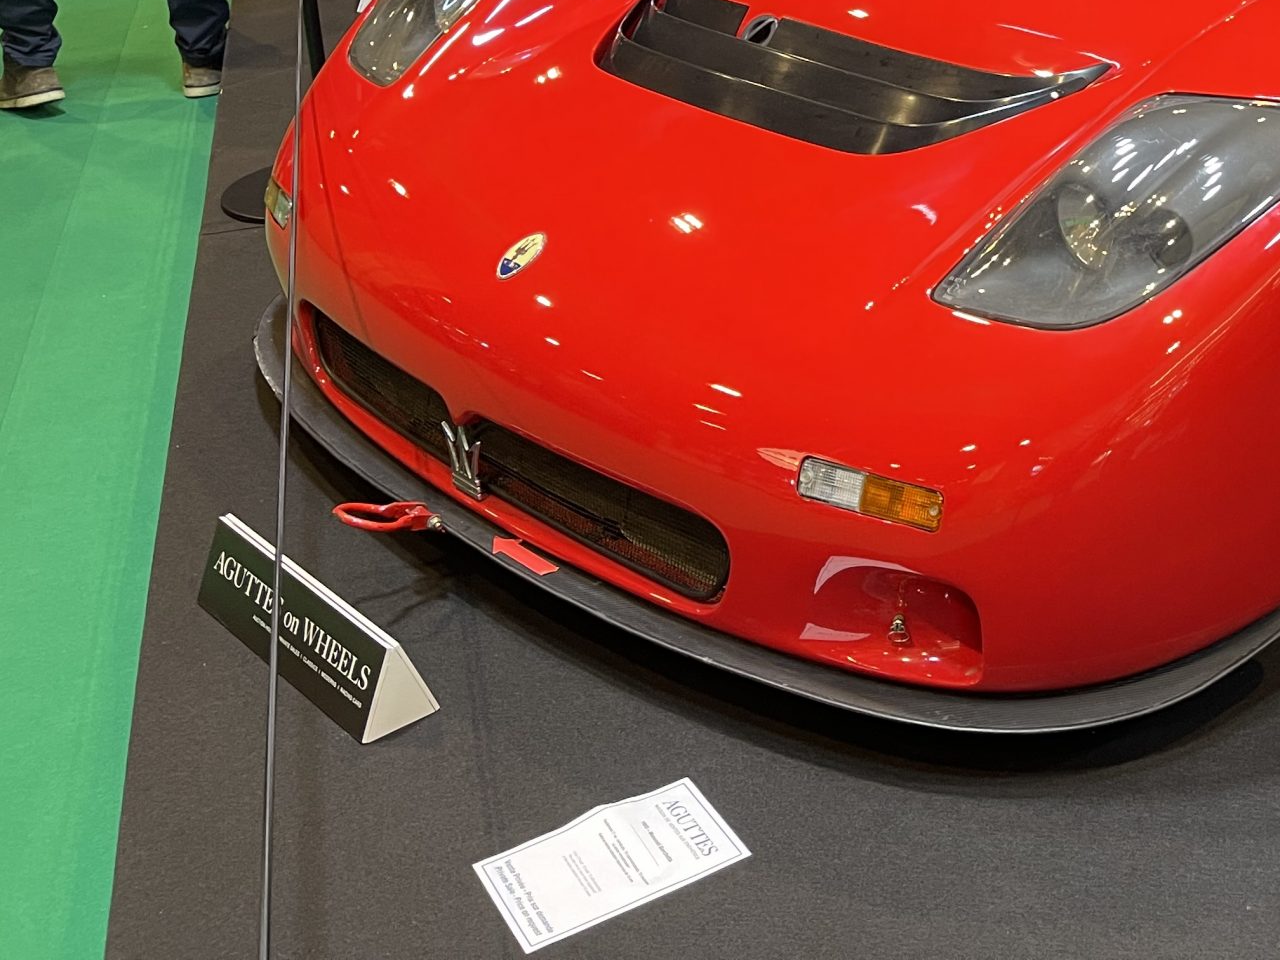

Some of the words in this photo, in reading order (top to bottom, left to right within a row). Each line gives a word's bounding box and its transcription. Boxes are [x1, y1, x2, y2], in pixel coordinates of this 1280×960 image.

[283, 611, 300, 635] on
[303, 616, 371, 691] WHEELS
[662, 799, 719, 857] AGUTTES
